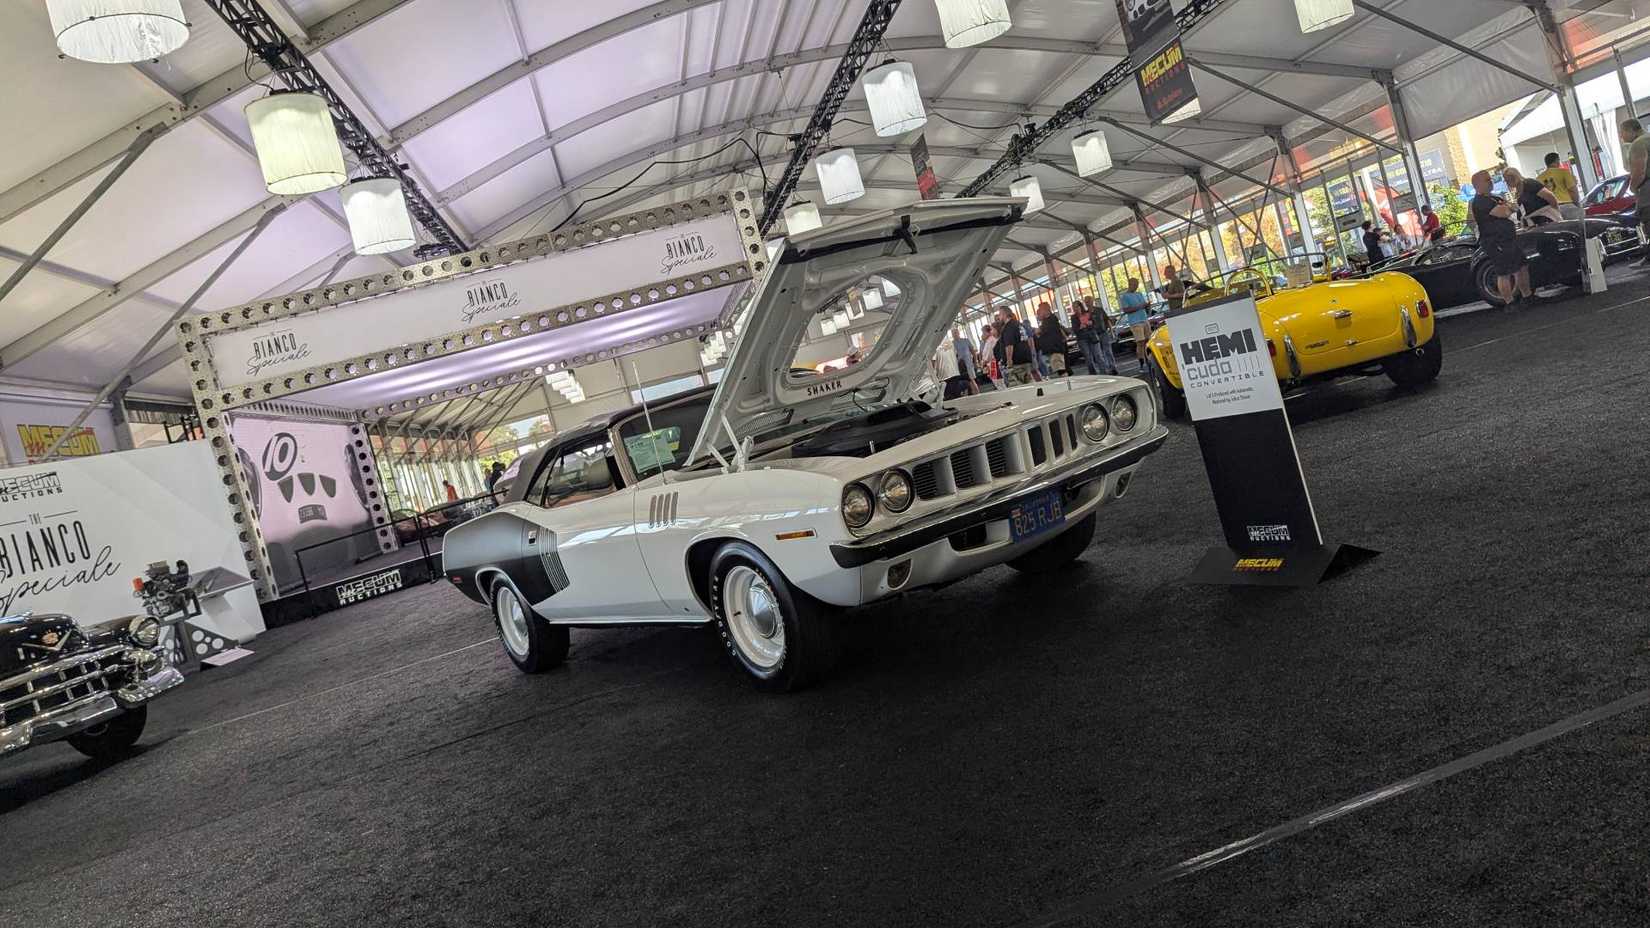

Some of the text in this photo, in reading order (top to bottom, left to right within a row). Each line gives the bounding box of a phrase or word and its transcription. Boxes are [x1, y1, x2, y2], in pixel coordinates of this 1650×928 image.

[1140, 43, 1183, 88] MECUM
[660, 245, 717, 275] Speciale
[665, 235, 705, 259] BIANCO
[460, 292, 522, 323] Speciale
[467, 282, 508, 306] BIANCO
[246, 343, 312, 376] Speciale
[253, 333, 297, 359] BIANCO
[1180, 328, 1257, 365] HEMI
[807, 380, 842, 396] SHAKER
[1190, 370, 1265, 389] CONVERTIBLE
[264, 435, 296, 473] 10
[0, 545, 121, 617] peciale
[339, 582, 403, 606] AUCTIONS
